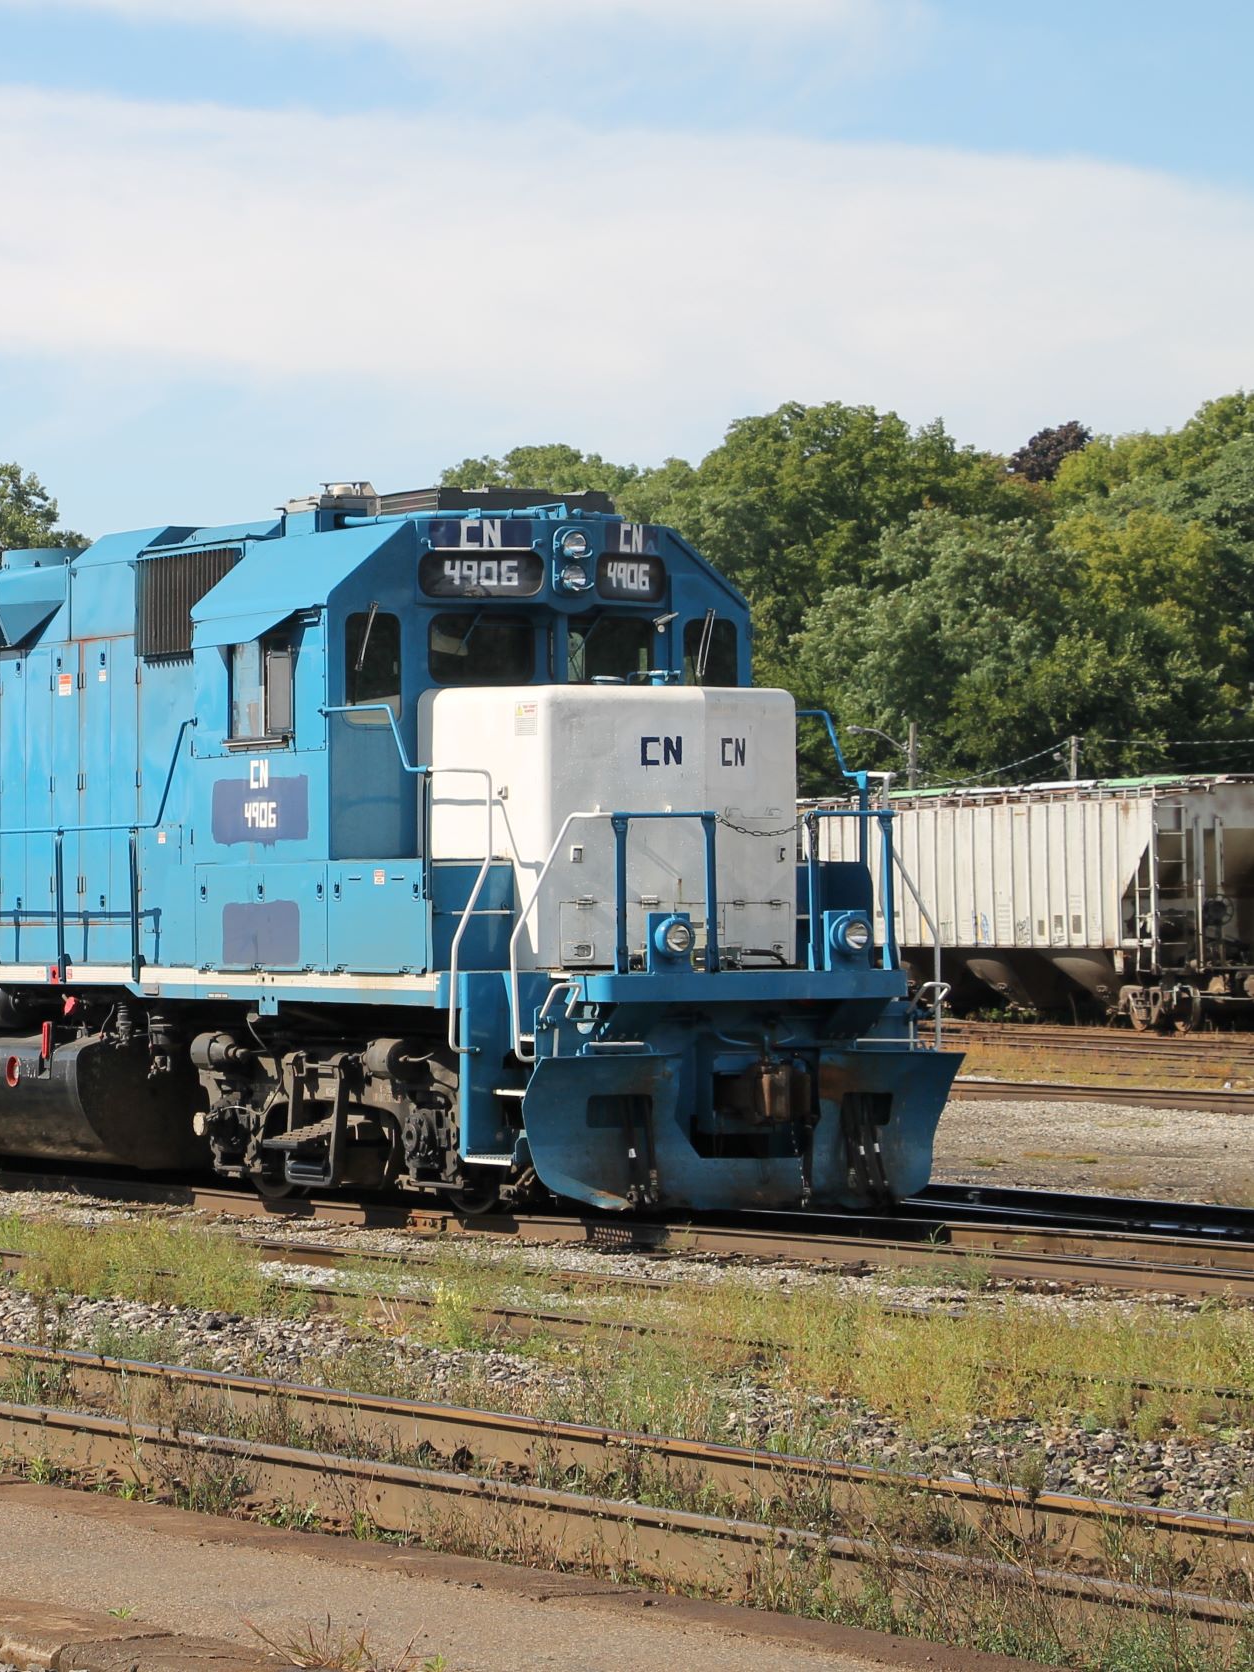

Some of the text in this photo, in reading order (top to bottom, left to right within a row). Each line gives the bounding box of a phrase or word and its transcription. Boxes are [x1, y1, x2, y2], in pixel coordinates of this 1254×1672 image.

[459, 519, 502, 548] CN
[619, 523, 643, 553] CN
[444, 560, 519, 586] 4906
[607, 562, 650, 591] 4906
[641, 735, 683, 766] CN
[721, 737, 746, 767] CN
[250, 759, 268, 789] CN
[244, 802, 277, 828] 4906
